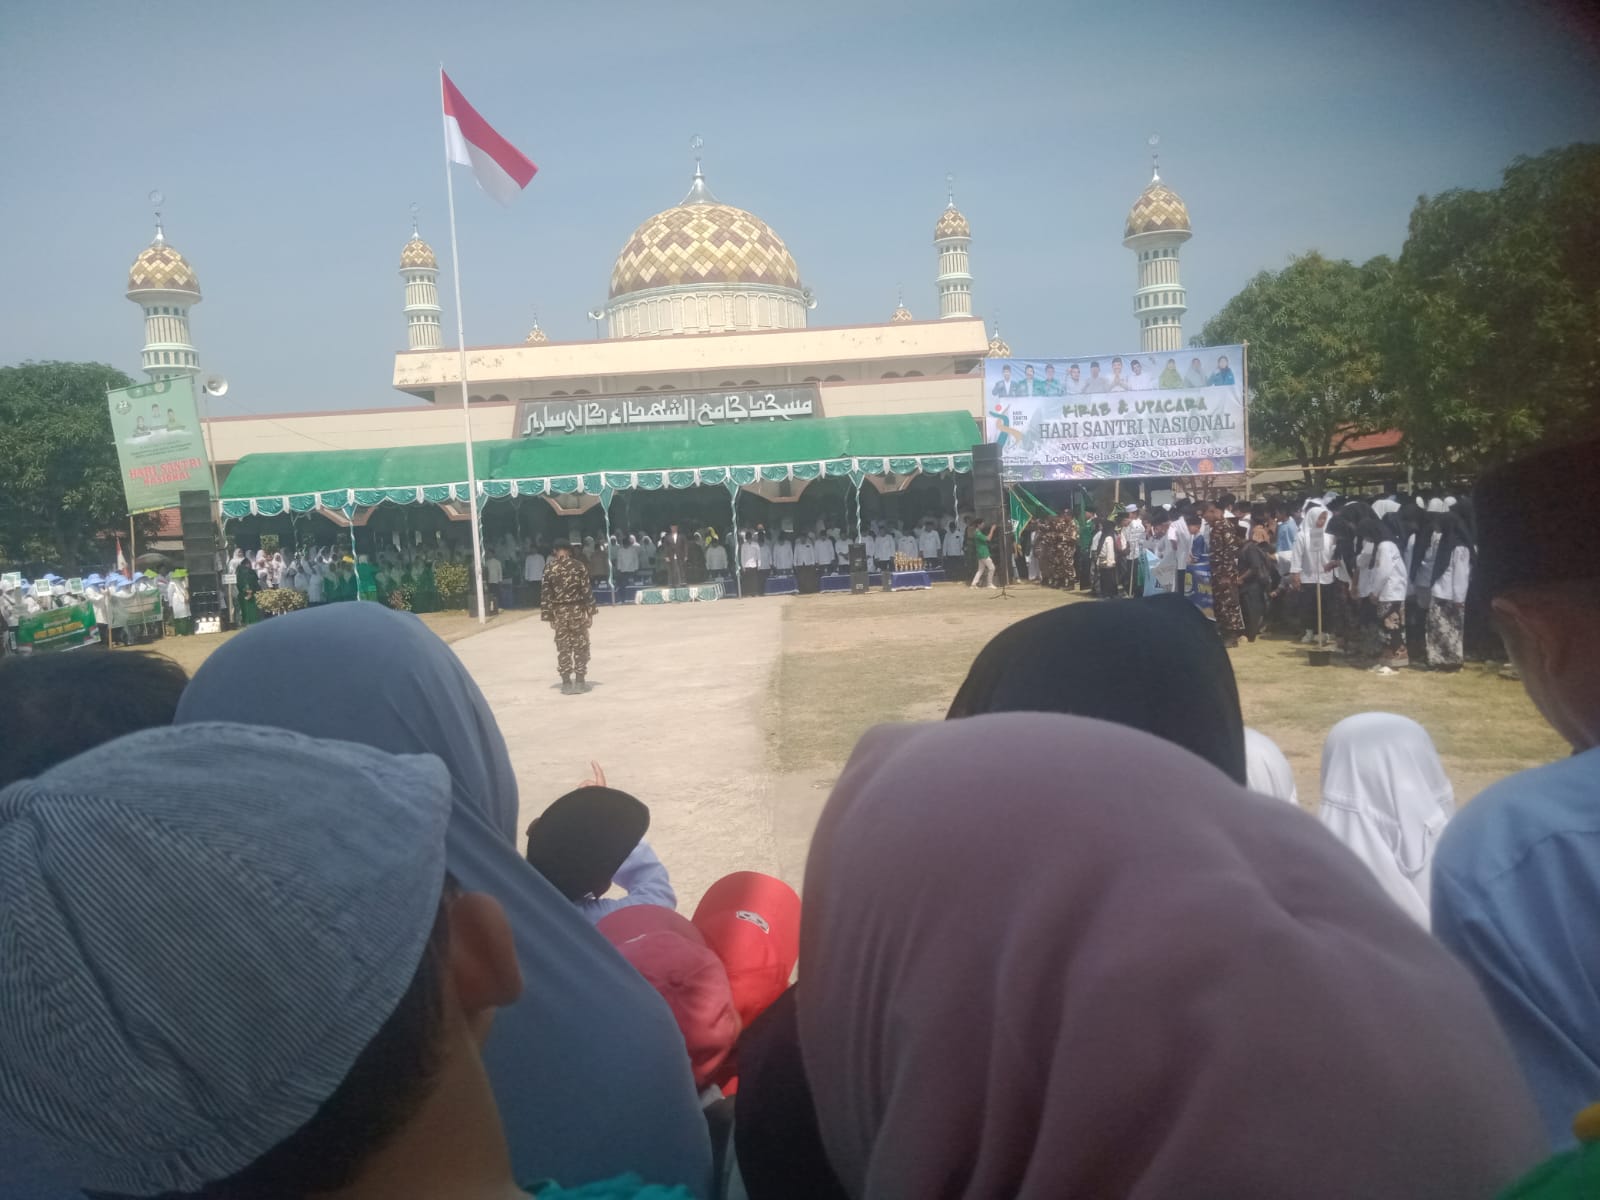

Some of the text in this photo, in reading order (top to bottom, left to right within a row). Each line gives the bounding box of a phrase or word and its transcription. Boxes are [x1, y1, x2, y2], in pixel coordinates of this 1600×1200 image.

[697, 395, 749, 427] جامع
[749, 393, 812, 422] مسجد
[1135, 396, 1208, 414] UPACARA
[1039, 413, 1236, 439] HARI SANTRI NASIONAL
[1060, 435, 1211, 451] MWC NU LOSARI CIREBON
[1132, 450, 1146, 459] 22
[1150, 448, 1196, 458] Oktober
[1200, 447, 1229, 456] 2024
